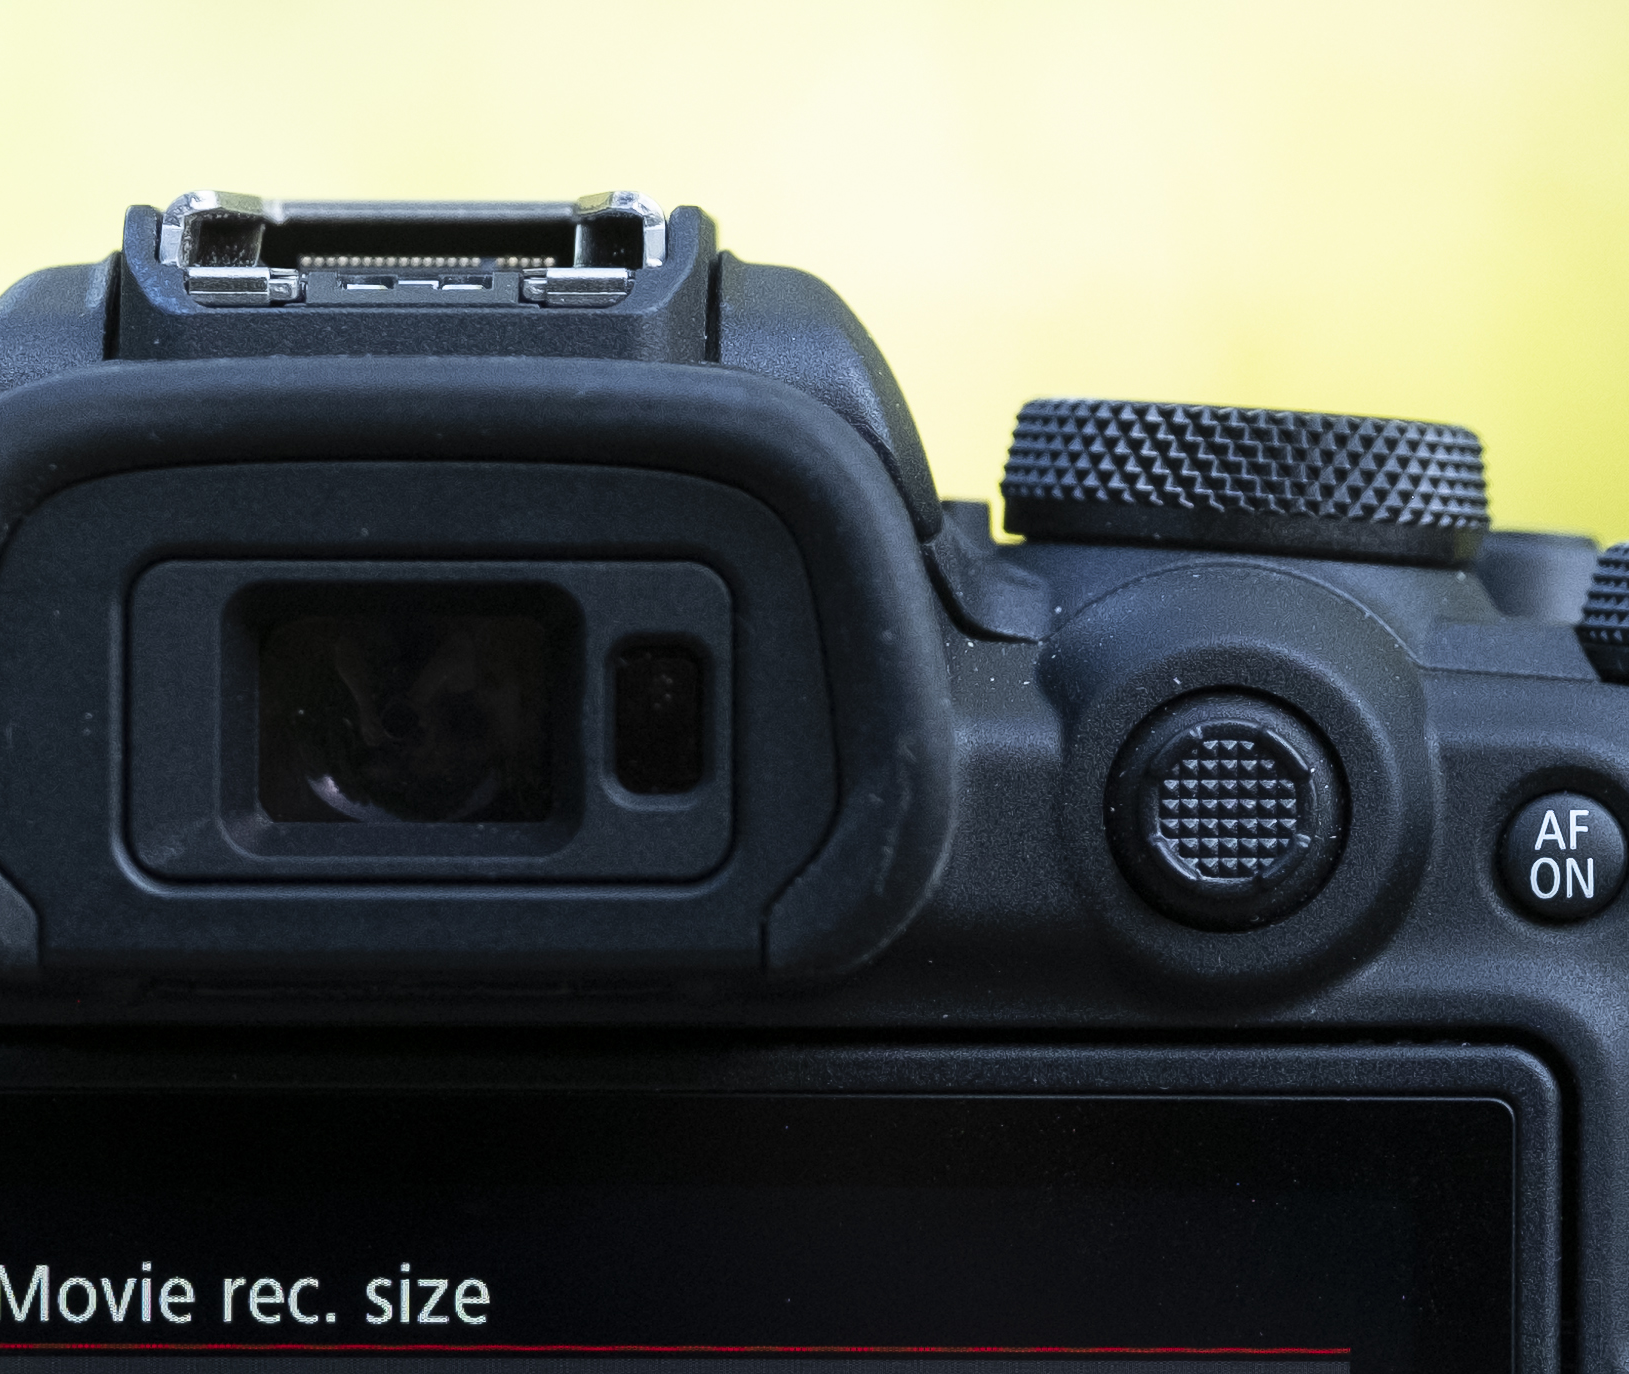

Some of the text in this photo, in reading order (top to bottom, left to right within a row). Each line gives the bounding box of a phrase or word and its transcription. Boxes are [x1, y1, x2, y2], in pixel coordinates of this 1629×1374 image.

[1534, 808, 1590, 851] AF
[1530, 857, 1594, 899] ON
[223, 1276, 336, 1325] rec.
[365, 1262, 491, 1325] size
